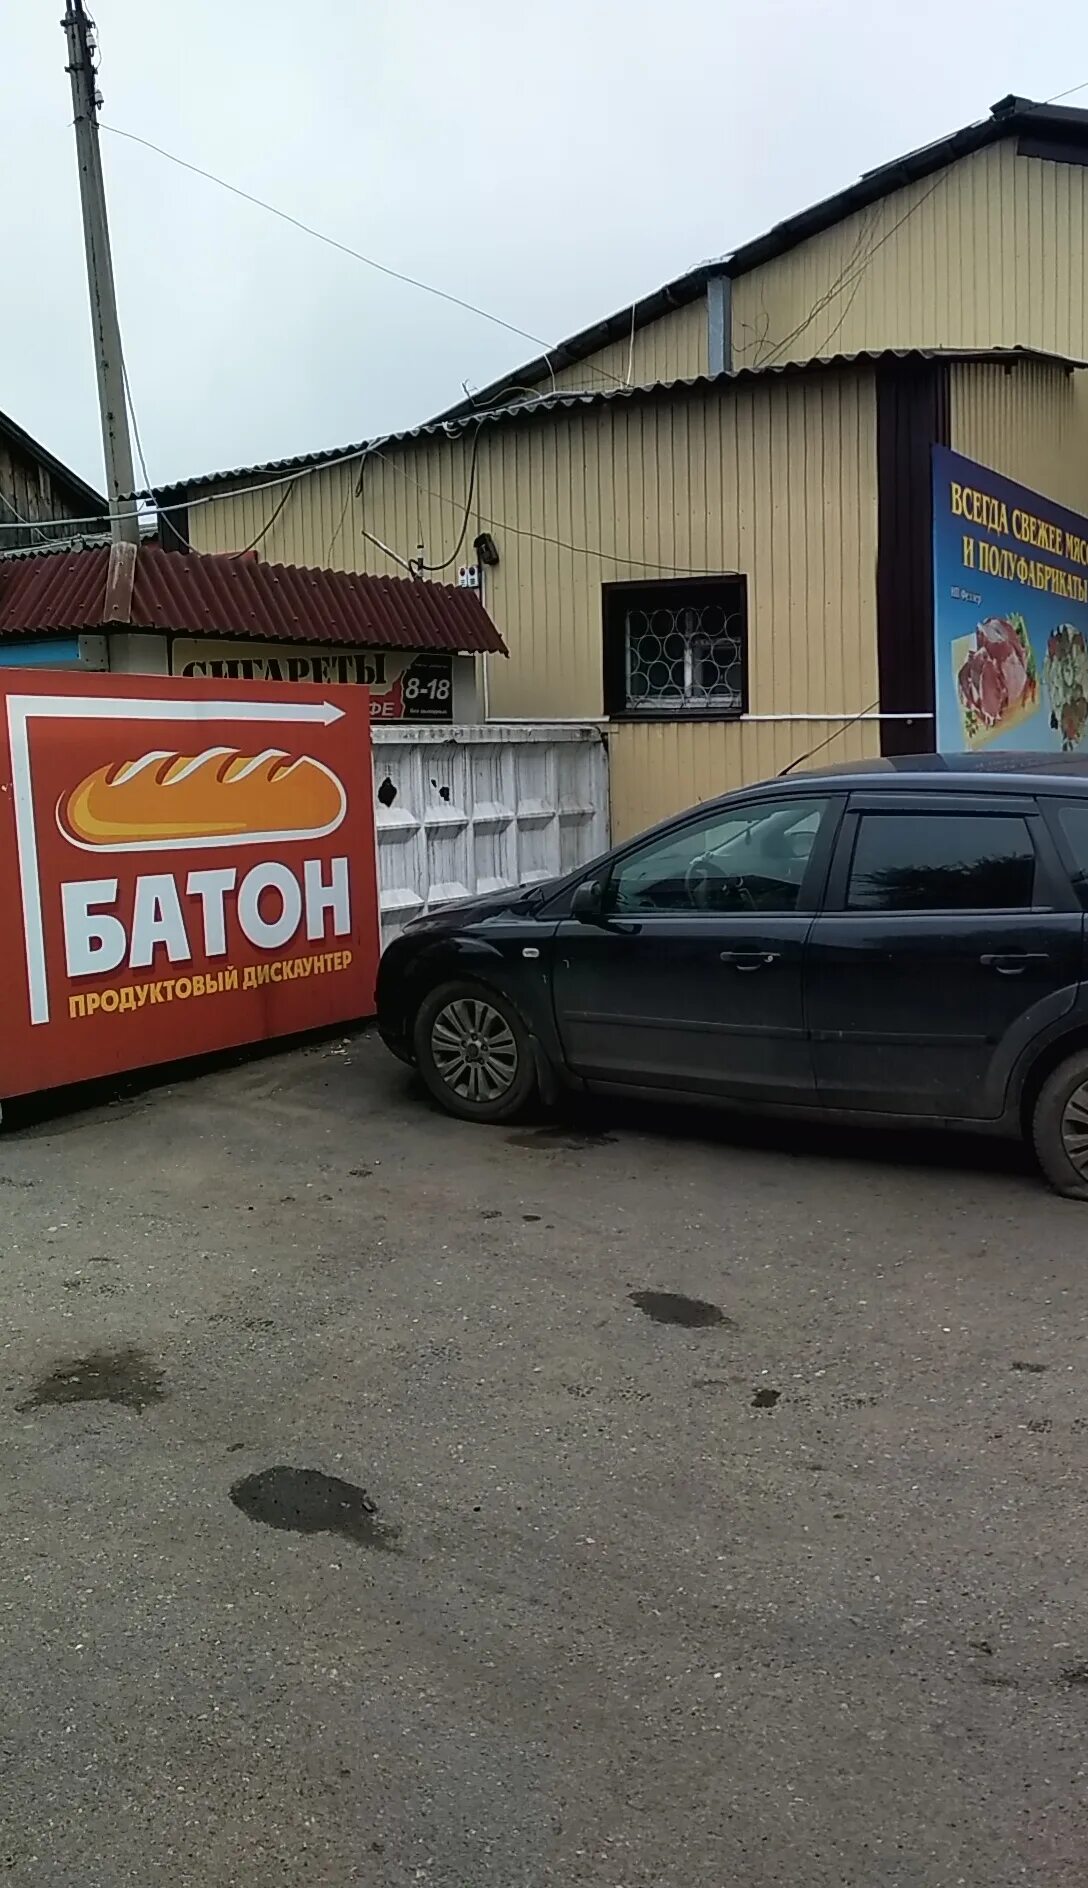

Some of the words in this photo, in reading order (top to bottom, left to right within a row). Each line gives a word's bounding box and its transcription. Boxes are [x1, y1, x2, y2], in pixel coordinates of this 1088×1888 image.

[950, 481, 1009, 535] ВСЕГДА
[1011, 508, 1063, 557] СВЕЖЕЕ
[962, 535, 975, 567] И
[978, 544, 1088, 603] ПОЛУФАБРИКАТЫ
[405, 677, 450, 700] 8-18
[61, 857, 351, 978] БАТОН
[69, 965, 239, 1018] ПРОДУКТОВЫЙ
[242, 950, 353, 990] ДИСКАУНТЕР
